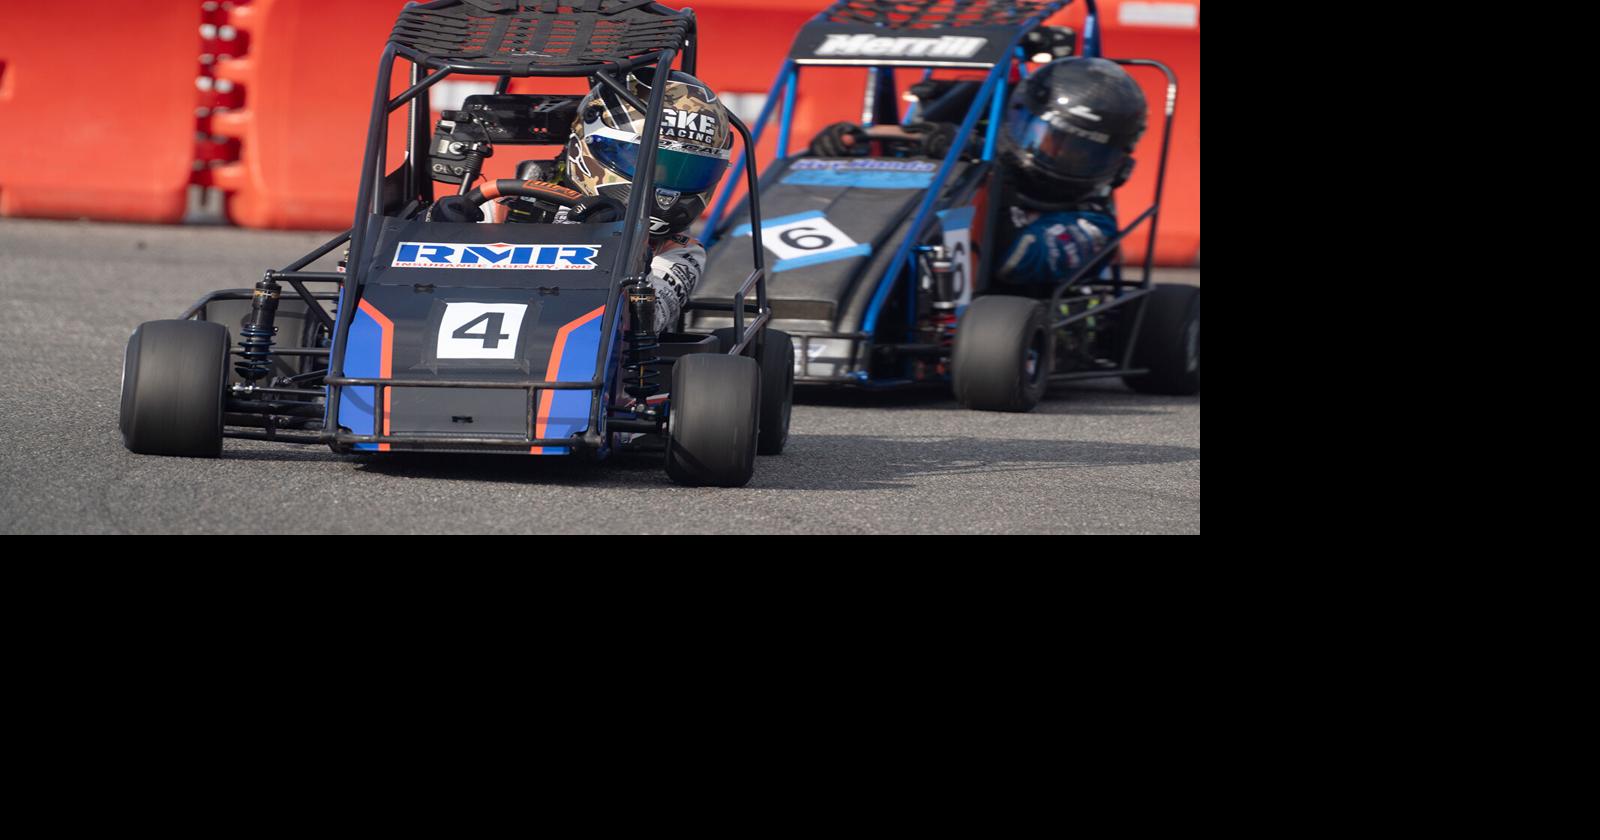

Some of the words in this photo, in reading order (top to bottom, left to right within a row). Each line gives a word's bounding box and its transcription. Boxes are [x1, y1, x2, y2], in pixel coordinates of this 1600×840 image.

[814, 34, 988, 58] Merrill
[660, 108, 715, 136] GKE
[779, 227, 833, 250] 6
[396, 244, 593, 265] RMR
[452, 312, 509, 350] 4
